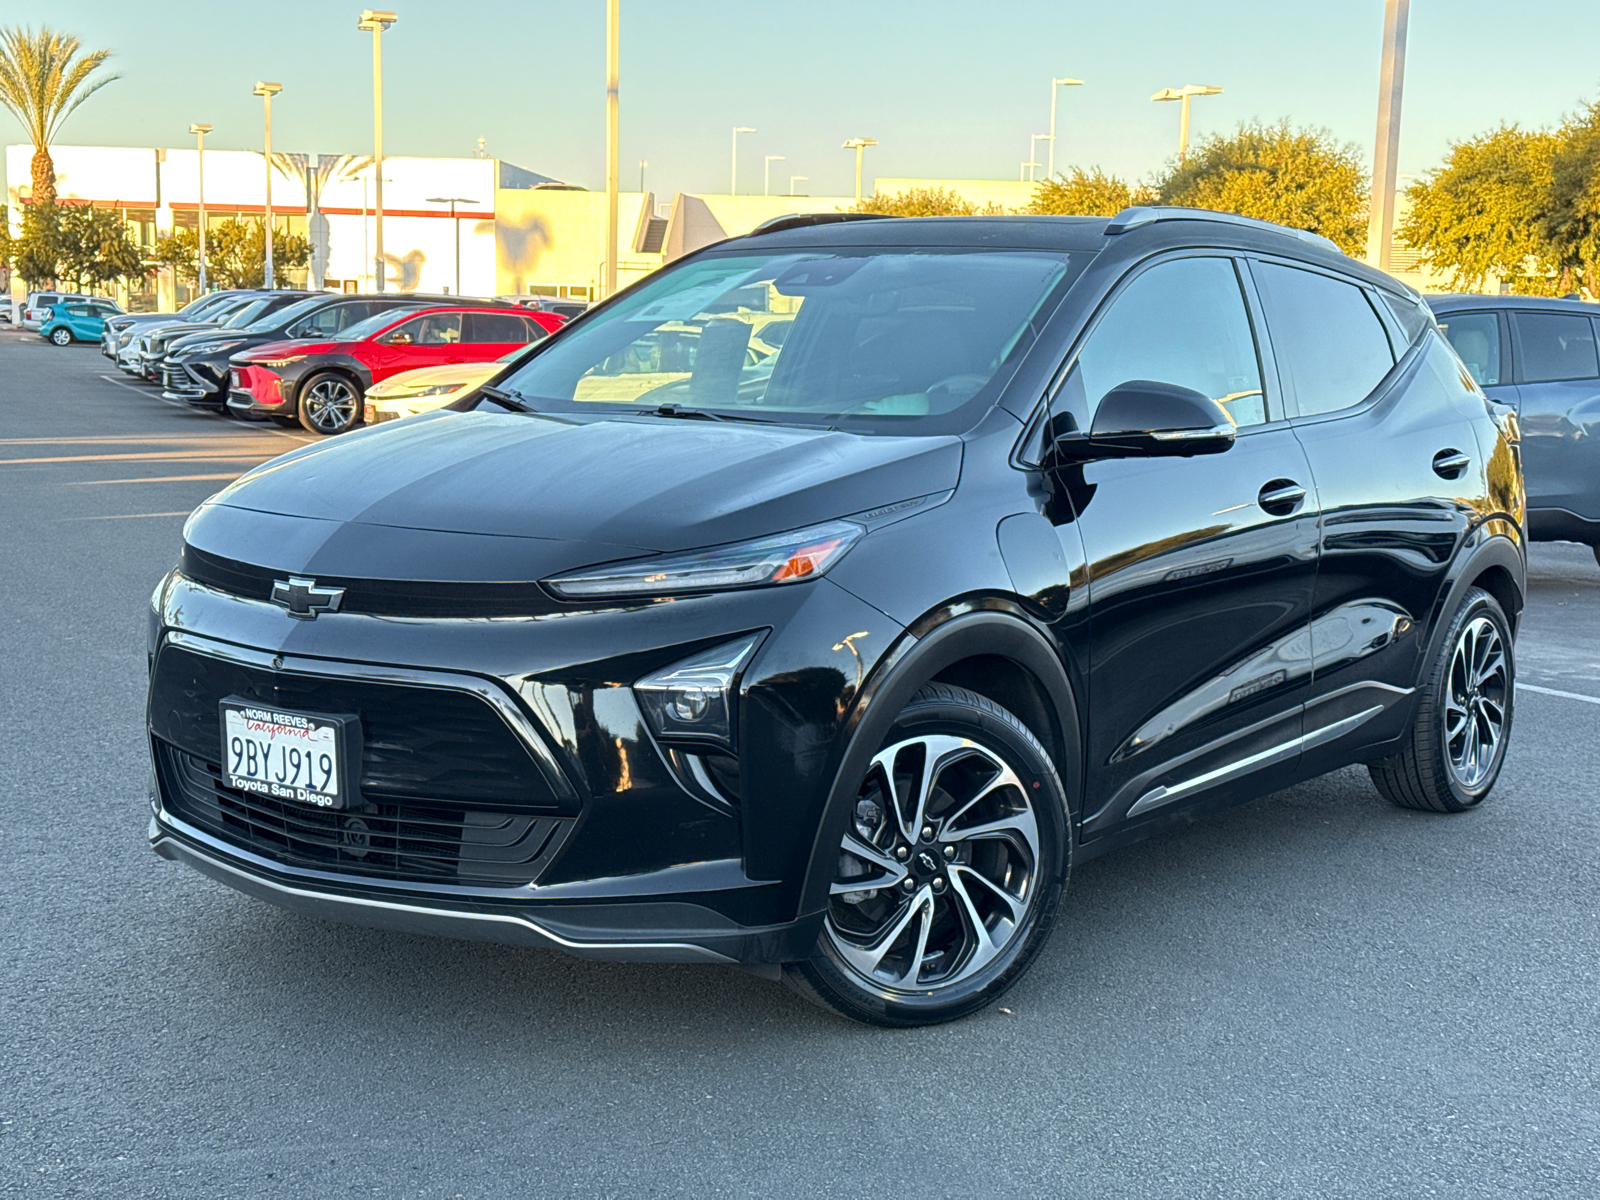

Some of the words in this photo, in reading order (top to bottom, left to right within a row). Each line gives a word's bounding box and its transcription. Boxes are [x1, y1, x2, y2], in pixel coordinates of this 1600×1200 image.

[246, 708, 271, 722] NORM
[273, 713, 308, 728] REEVES
[246, 720, 318, 742] California
[231, 736, 332, 792] 9BYJ919
[230, 775, 268, 793] Toyota
[271, 783, 294, 798] San
[297, 788, 332, 806] Diego
